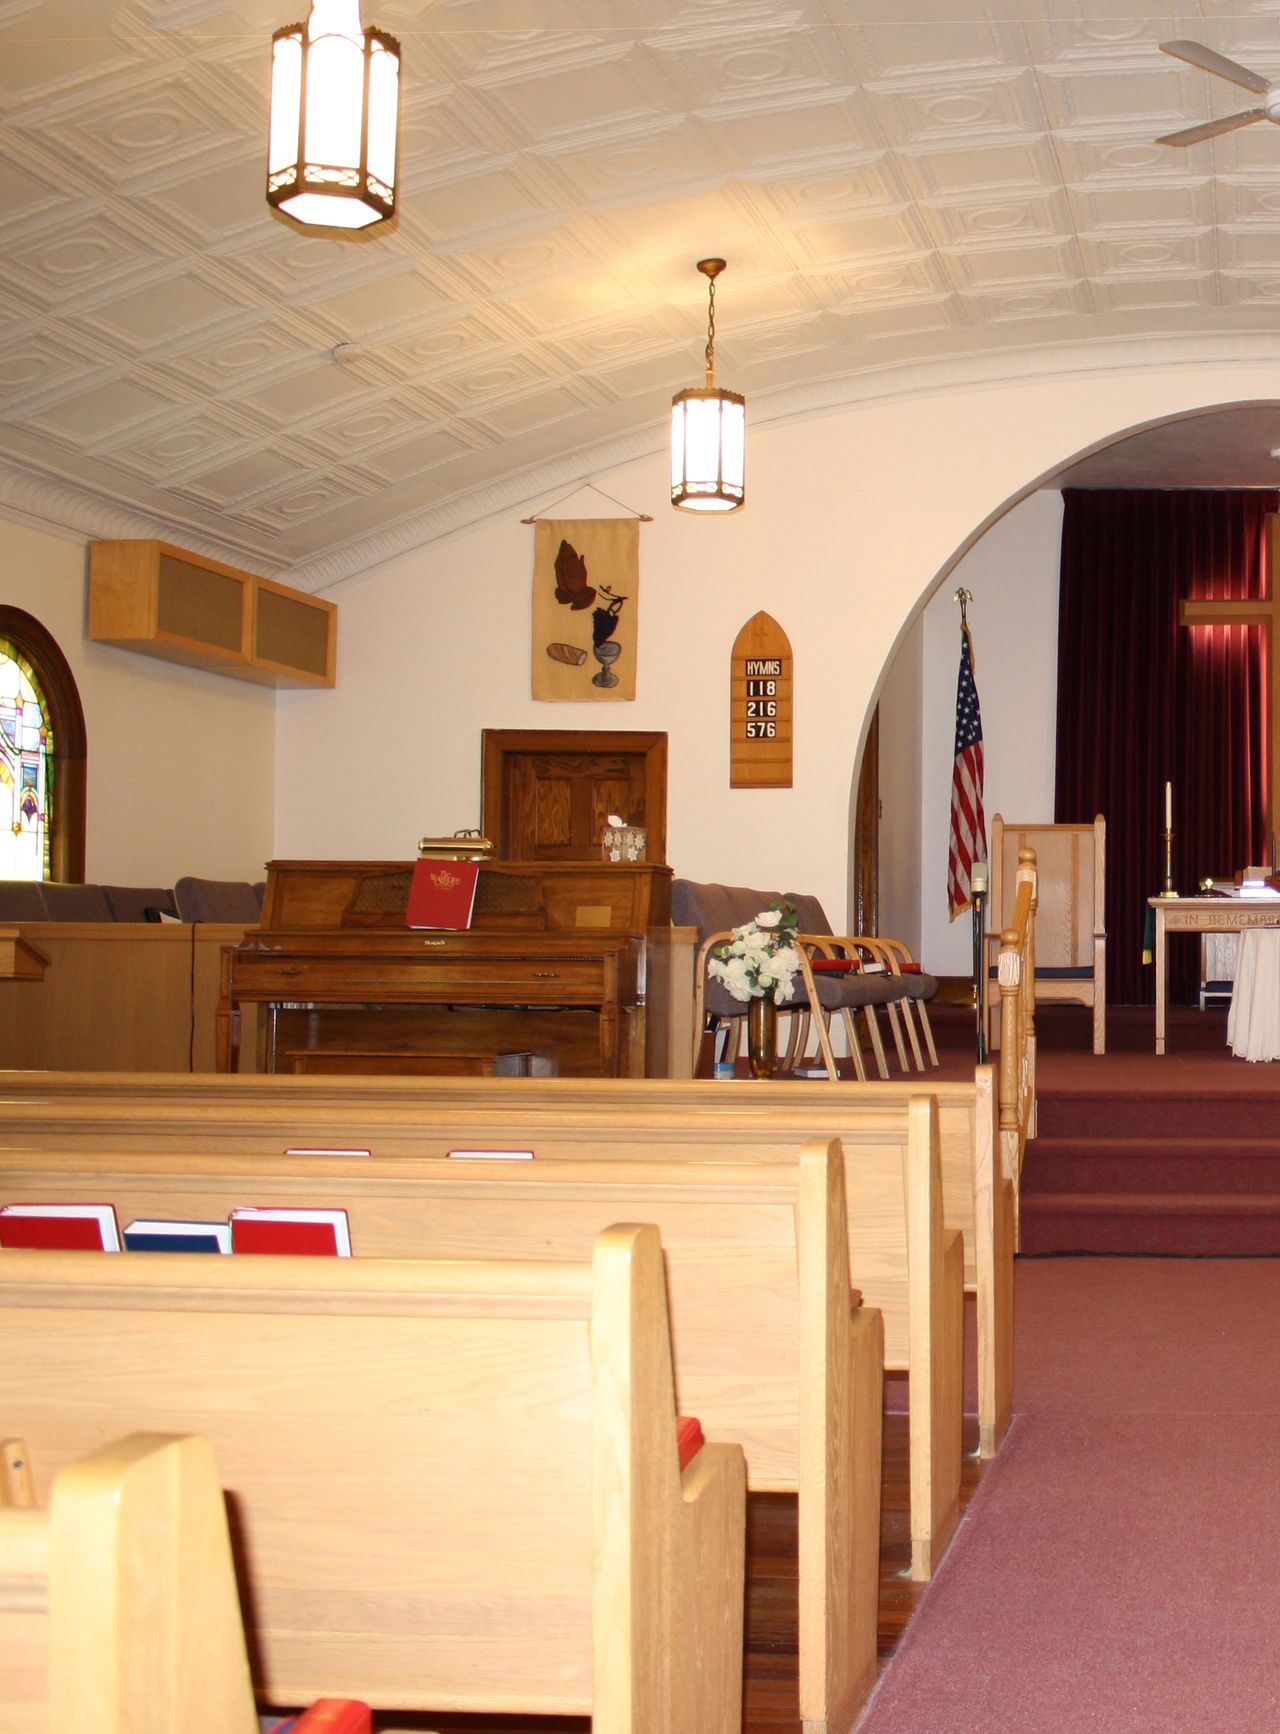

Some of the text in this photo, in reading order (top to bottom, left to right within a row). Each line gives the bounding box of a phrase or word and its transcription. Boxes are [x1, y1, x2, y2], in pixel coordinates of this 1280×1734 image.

[746, 661, 780, 676] HYMNS
[749, 681, 776, 696] 118
[747, 702, 776, 717] 216
[746, 722, 776, 737] 576
[1184, 914, 1199, 926] IN
